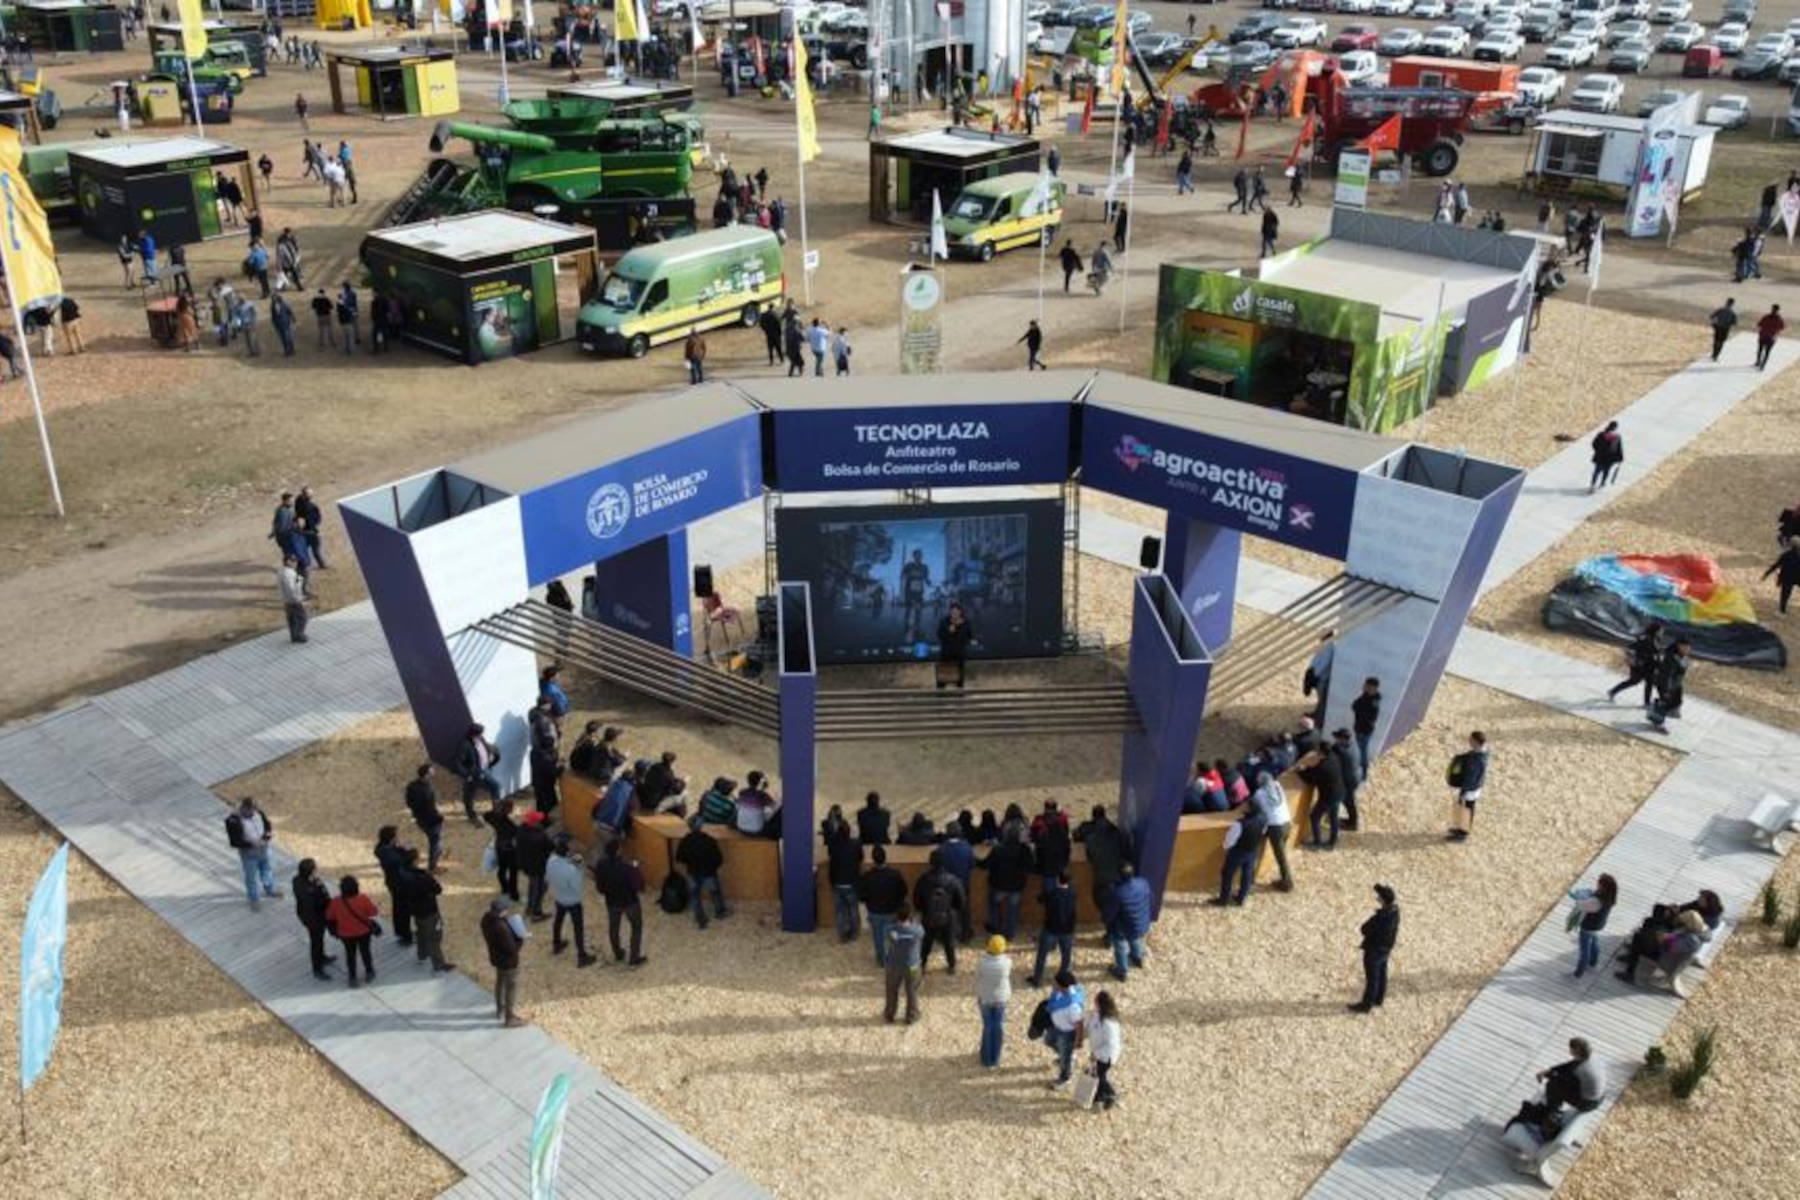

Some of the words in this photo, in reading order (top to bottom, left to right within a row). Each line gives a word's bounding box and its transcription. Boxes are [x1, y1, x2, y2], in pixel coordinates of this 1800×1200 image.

[1255, 296, 1295, 314] casafe
[854, 422, 989, 442] TECNOPLAZA
[885, 445, 957, 458] Anfiteatro
[823, 463, 861, 477] Bolsa
[863, 463, 880, 475] de
[882, 461, 947, 475] Comercio
[949, 460, 966, 472] de
[968, 458, 1021, 472] Rosario
[1152, 449, 1284, 501] agroactiva
[633, 473, 668, 492] BOLSA
[634, 490, 650, 506] DE
[650, 469, 709, 499] COMERCIO
[635, 503, 651, 518] DE
[651, 485, 699, 512] ROSARIO
[1211, 488, 1282, 521] AXION
